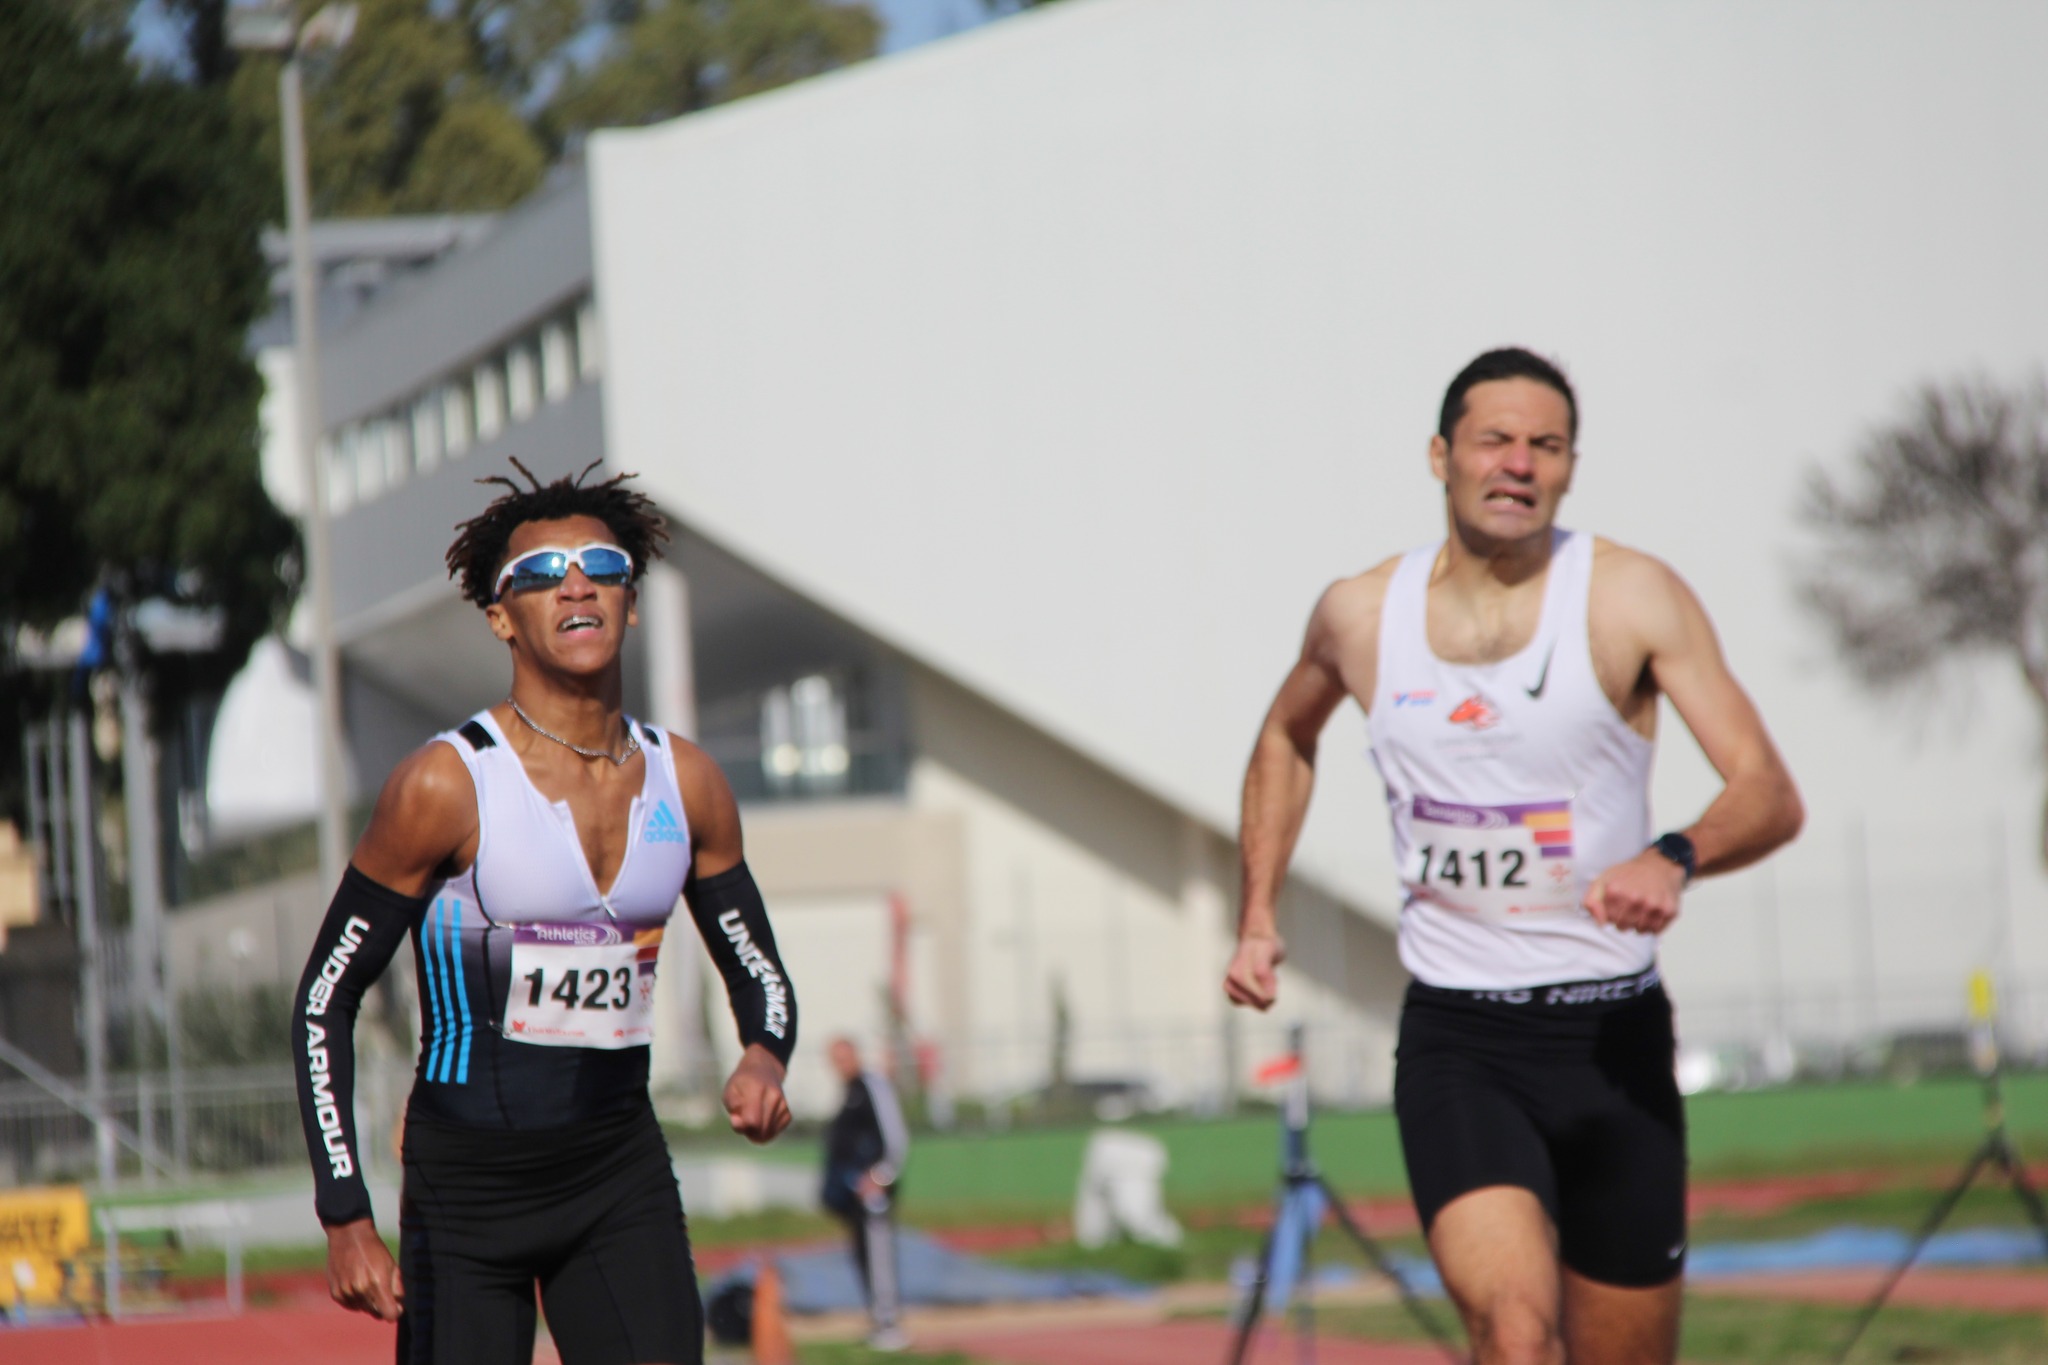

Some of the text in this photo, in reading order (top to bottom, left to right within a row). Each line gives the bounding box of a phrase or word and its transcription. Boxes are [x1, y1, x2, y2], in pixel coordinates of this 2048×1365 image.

[644, 828, 687, 843] adidas
[1419, 844, 1528, 888] 1412
[537, 925, 597, 941] Athletics
[524, 967, 631, 1010] 1423
[306, 915, 370, 1180] UNDER ARMOUR
